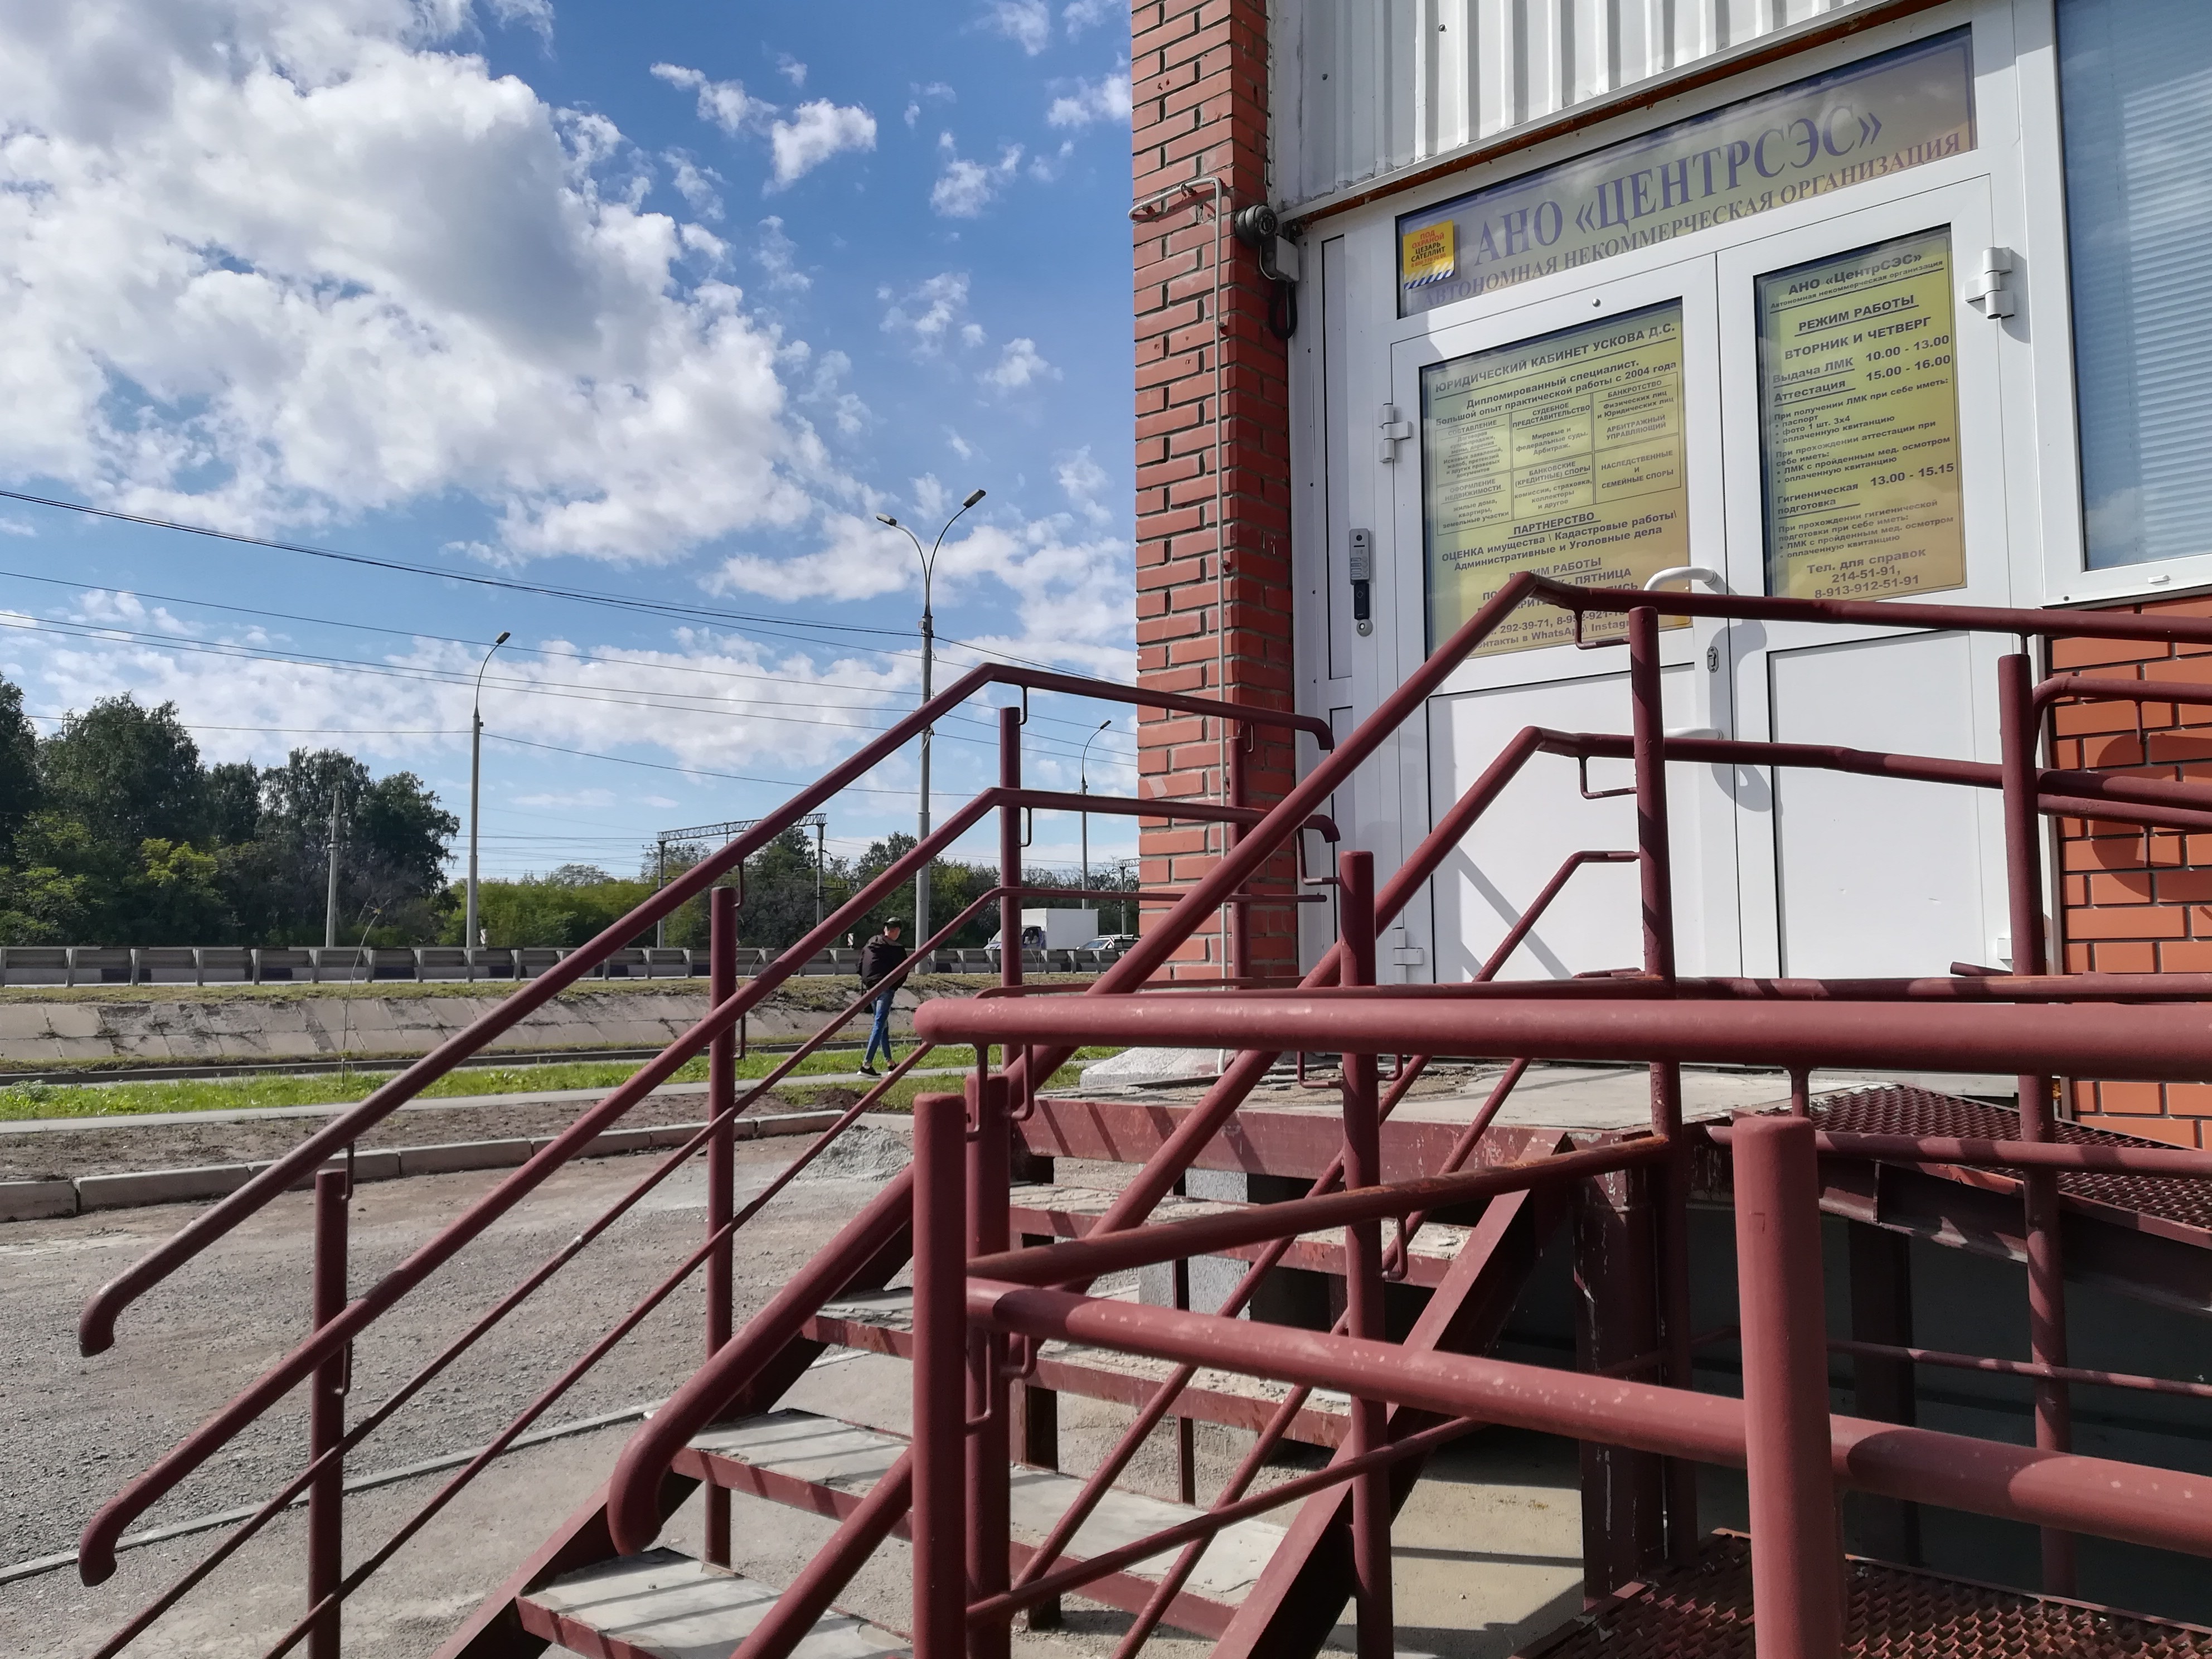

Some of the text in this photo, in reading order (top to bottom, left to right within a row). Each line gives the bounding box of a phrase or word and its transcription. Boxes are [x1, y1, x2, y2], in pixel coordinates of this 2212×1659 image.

[1474, 105, 1883, 266] АНО «ЦЕНТРСЭС»
[1423, 132, 1961, 307] АВТОНОМНАЯ НЕКОММЕРЧЕСКАЯ ОРГАНИЗАЦИЯ
[1411, 232, 1444, 249] ОХРАНОЙ
[1420, 230, 1435, 240] ПОД
[1411, 246, 1445, 261] САТЕЛЛИТ
[1415, 242, 1440, 254] ЦЕЗАРЬ
[1770, 260, 1943, 308] Автономная некоммерческая организация
[1788, 254, 1922, 295] АНО «ЦентрСЭС»
[1799, 294, 1913, 331] РЕЖИМ РАБОТЫ
[1785, 316, 1930, 360] ВТОРНИК И ЧЕТВЕРГ
[1866, 334, 1949, 361] 10.00 13.00
[1435, 323, 1675, 392] ЮРИДИЧЕСКИЙ КАБИНЕТ УСКОВА Д.С.
[1773, 357, 1853, 383] Выдача ЛМК
[1866, 355, 1950, 381] 15.00 16.00
[1436, 410, 1476, 425] Большой
[1479, 405, 1502, 415] опыт
[1505, 386, 1572, 409] практической
[1575, 377, 1612, 394] работы
[1625, 367, 1649, 380] 2004
[1653, 362, 1676, 372] года
[1466, 360, 1638, 410] Дипломированный специалист.
[1608, 380, 1661, 397] БАНКРОТСТВО
[1774, 380, 1845, 402] Аттестация
[1603, 395, 1650, 409] Физических
[1794, 401, 1843, 416] получении
[1846, 394, 1867, 405] ЛМК
[1890, 385, 1913, 395] себе
[1917, 378, 1948, 389] иметь:
[1512, 405, 1590, 428] ПРЕДСТАВИТЕЛЬСТВО
[1532, 402, 1569, 415] СУДЕБНОЕ
[1604, 401, 1656, 417] Юридических
[1448, 420, 1496, 435] СОСТАВЛЕНИЕ
[1606, 421, 1666, 440] УПРАВЛЯЮЩИЙ
[1607, 414, 1665, 433] АРБИТРАЖНЫЙ
[1782, 415, 1818, 427] паспорт
[1782, 426, 1805, 436] фото
[1783, 416, 1894, 443] оплаченную квитанцию
[1516, 431, 1588, 452] федеральные суды.
[1532, 429, 1564, 440] Мировые
[1776, 421, 1936, 458] При прохождении аттестации при
[1533, 443, 1570, 455] Арбитраж.
[1784, 464, 1804, 474] ЛМК
[1815, 452, 1874, 468] пройденным
[1902, 437, 1950, 450] осмотром
[1529, 461, 1575, 476] БАНКОВСКИЕ
[1601, 450, 1672, 470] НАСЛЕДСТВЕННЫЕ
[1776, 452, 1829, 467] себе иметь:
[1784, 457, 1896, 482] оплаченную квитанцию
[1456, 467, 1490, 478] документов
[1515, 465, 1590, 487] (КРЕДИТНЫЕ) СПОРЫ
[1602, 469, 1673, 488] СЕМЕЙНЫЕ СПОРЫ
[1870, 463, 1953, 486] 13.00 15.15
[1445, 484, 1501, 501] НЕДВИЖИМОСТИ
[1450, 478, 1495, 492] ОФОРМЛЕНИЕ
[1514, 479, 1592, 498] комиссии, страховка,
[1777, 483, 1858, 503] Гигиеническая
[1478, 499, 1497, 507] дома,
[1531, 490, 1574, 503] коллекторы
[1544, 499, 1568, 509] другое
[1778, 499, 1836, 514] подготовка
[1443, 511, 1508, 528] земельные участки
[1458, 507, 1492, 518] квартиры,
[1798, 514, 1861, 530] прохождении
[1865, 499, 1937, 518] гигиенической
[1514, 512, 1594, 535] ПАРТНЕРСТВО
[1778, 529, 1828, 542] подготовки
[1851, 520, 1874, 529] себе
[1877, 515, 1908, 525] иметь:
[1787, 540, 1806, 549] ЛМК
[1818, 530, 1878, 545] пройденным
[1905, 517, 1953, 529] осмотром
[1442, 547, 1484, 561] ОЦЕНКА
[1487, 537, 1545, 553] имущества
[1555, 521, 1628, 540] Кадастровые
[1454, 546, 1555, 571] Административные
[1569, 533, 1630, 549] Уголовные
[1634, 527, 1662, 539] дела
[1787, 535, 1899, 557] оплаченную квитанцию
[1553, 557, 1600, 573] РАБОТЫ
[1807, 549, 1925, 574] Тел. для справок
[1575, 568, 1631, 586] ПЯТНИЦА
[1832, 565, 1900, 583] 214-51-91,
[1815, 575, 1918, 600] 8-913-912-51-91
[1500, 619, 1553, 633] 292-39-71,
